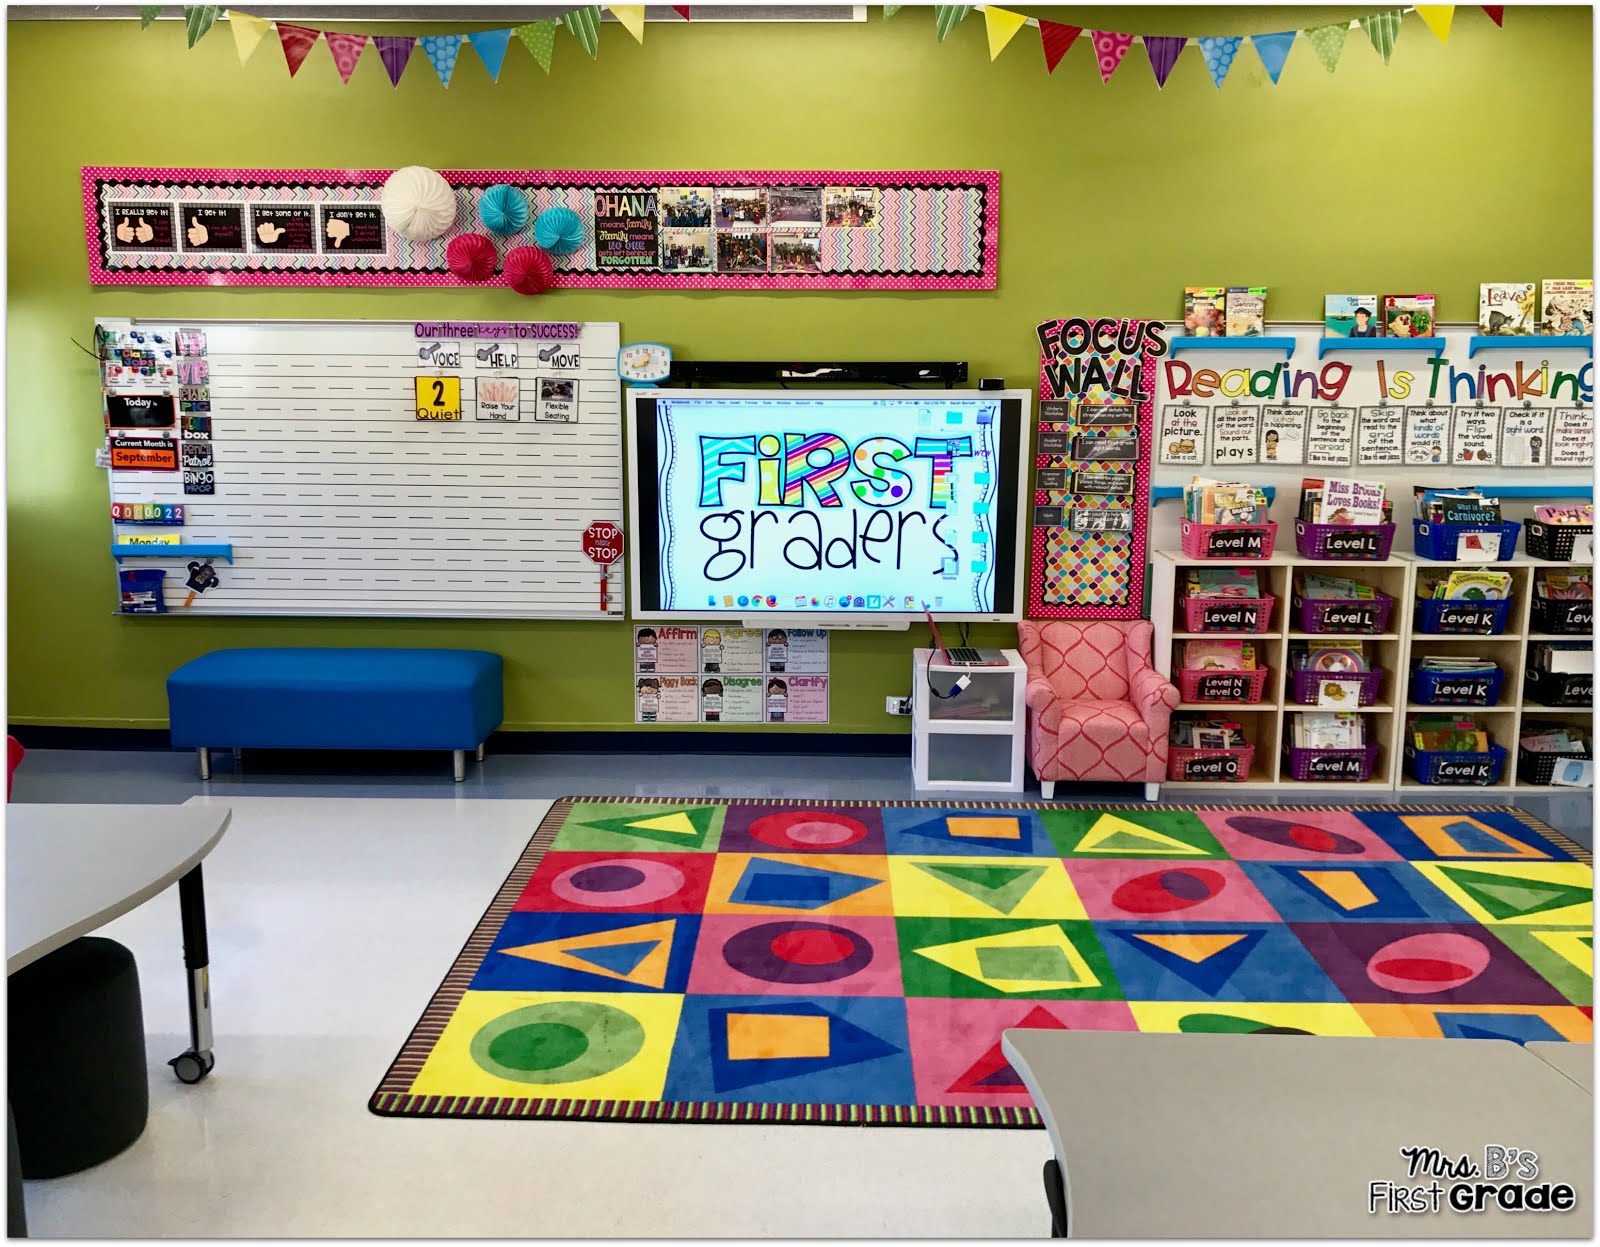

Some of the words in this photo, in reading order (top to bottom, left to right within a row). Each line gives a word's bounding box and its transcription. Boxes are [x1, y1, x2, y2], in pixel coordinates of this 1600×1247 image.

[594, 195, 658, 217] OHANA
[624, 219, 652, 230] family
[608, 242, 622, 250] NO
[624, 242, 646, 250] ONE
[600, 256, 652, 264] FORGOTTEN
[1487, 288, 1527, 306] Leaves
[414, 323, 435, 337] Our
[442, 323, 474, 338] three
[477, 324, 509, 338] keys
[514, 324, 527, 338] to
[530, 324, 578, 338] SUCCESS!
[1036, 317, 1169, 360] FOCUS
[432, 352, 459, 366] VOICE
[490, 353, 517, 367] HELP
[551, 354, 580, 368] MOVE
[178, 360, 209, 384] VIP
[1044, 357, 1151, 401] WALL
[1164, 360, 1352, 400] Reading
[1376, 360, 1415, 400] Is
[1427, 358, 1593, 403] Thinking
[432, 380, 446, 407] 2
[124, 398, 152, 408] Today
[481, 402, 498, 410] Raise
[500, 402, 516, 410] Your
[545, 402, 569, 410] Flexible
[416, 408, 460, 420] Quiet
[544, 412, 570, 421] Seating
[1174, 409, 1197, 418] Look
[1317, 410, 1328, 418] Go
[1331, 410, 1350, 418] back
[1370, 410, 1395, 418] Skip
[1171, 418, 1180, 427] at
[1182, 418, 1198, 428] the
[184, 430, 210, 440] box
[1164, 427, 1202, 436] picture.
[1466, 425, 1486, 434] Flip
[1506, 426, 1522, 436] sight
[1314, 443, 1344, 451] reread
[116, 452, 172, 464] September
[182, 455, 212, 467] Patrol
[1328, 480, 1350, 494] Miss
[1352, 483, 1381, 497] Brooks
[1327, 494, 1352, 507] Loves
[1352, 496, 1380, 510] Books!
[1447, 510, 1495, 521] Carnivore?
[588, 527, 618, 540] STOP
[699, 508, 959, 582] graders
[1209, 536, 1244, 549] Level
[1248, 536, 1261, 549] M
[1326, 537, 1364, 550] Level
[1368, 538, 1376, 550] L
[588, 546, 618, 559] STOP
[1204, 611, 1242, 624] Level
[1245, 612, 1257, 624] N
[1324, 611, 1360, 624] Level
[1364, 612, 1373, 625] L
[1440, 612, 1478, 625] Level
[1482, 613, 1493, 626] K
[1566, 612, 1593, 624] Lev
[658, 627, 698, 640] Affirm
[724, 628, 762, 639] Agree
[788, 629, 814, 637] Follow
[816, 629, 827, 640] Up
[660, 676, 678, 688] Piggy
[680, 677, 698, 686] Back
[724, 676, 763, 688] Disagree
[788, 676, 827, 688] Clarify
[1205, 678, 1232, 687] Level
[1234, 678, 1242, 688] N
[1204, 688, 1231, 696] Level
[1233, 688, 1242, 696] O
[1434, 683, 1474, 695] Level
[1476, 684, 1487, 696] K
[1186, 762, 1222, 774] Level
[1226, 761, 1237, 774] O
[1309, 760, 1342, 772] Level
[1346, 760, 1360, 772] M
[1438, 764, 1474, 776] Level
[1478, 764, 1488, 778] K
